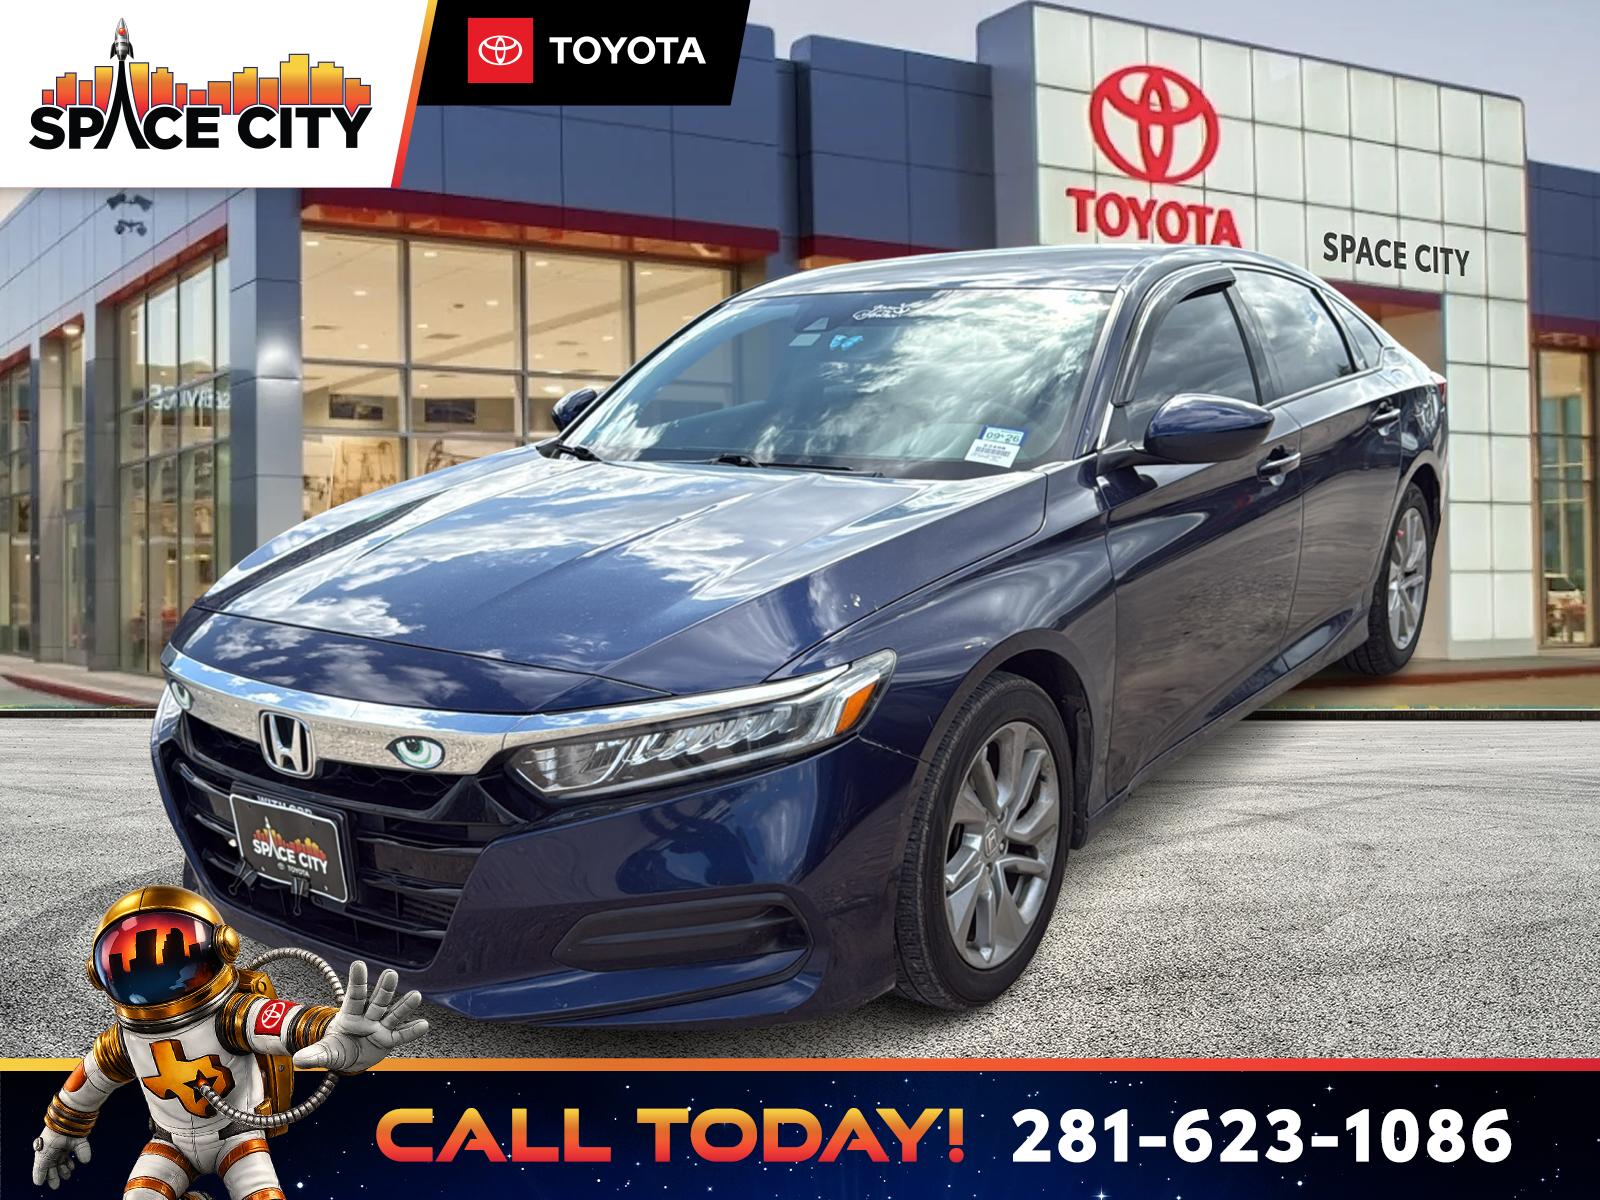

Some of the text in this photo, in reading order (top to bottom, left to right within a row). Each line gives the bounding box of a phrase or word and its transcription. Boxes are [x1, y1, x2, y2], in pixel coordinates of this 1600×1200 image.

[1066, 186, 1243, 248] TOYOTA
[1323, 231, 1471, 277] SPACE CITY
[252, 836, 329, 875] SPACE CITY
